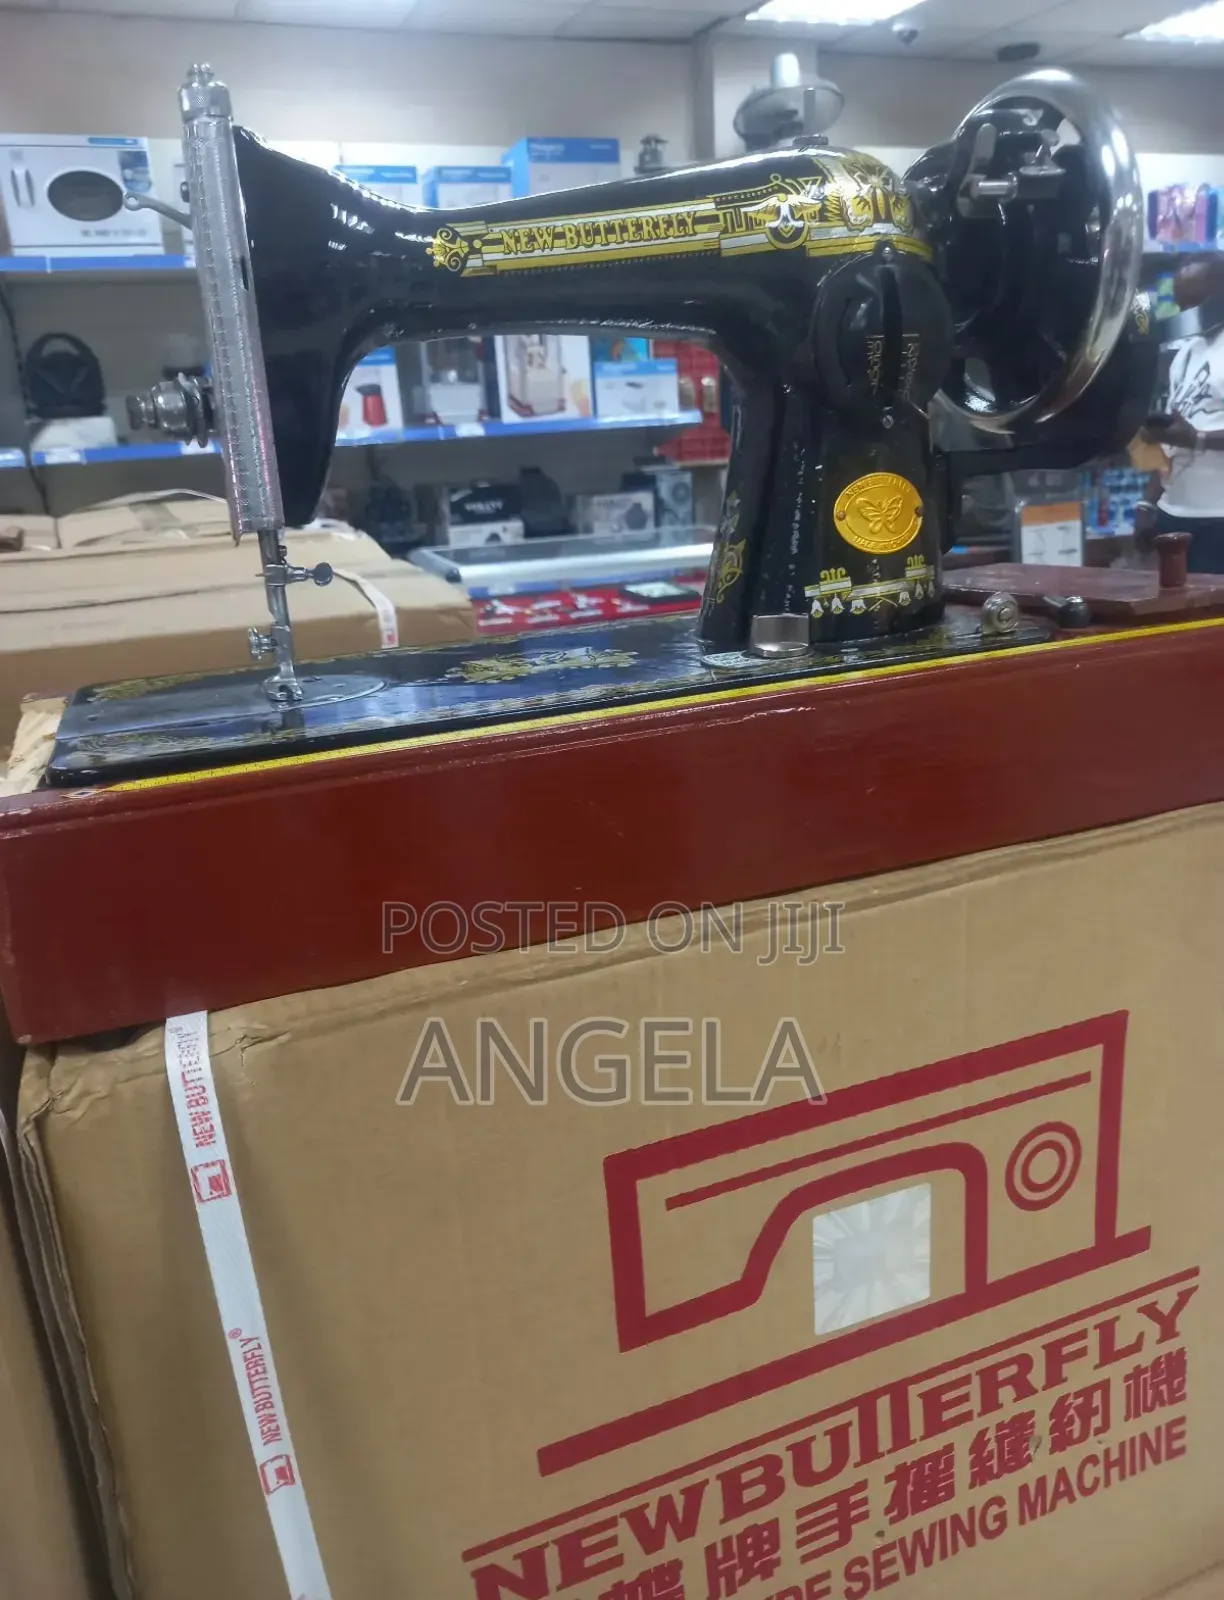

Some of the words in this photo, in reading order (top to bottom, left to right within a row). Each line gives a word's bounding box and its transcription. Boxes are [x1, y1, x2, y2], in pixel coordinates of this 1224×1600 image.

[500, 225, 554, 255] NEW
[564, 211, 698, 249] BUTTERFLY
[189, 1110, 216, 1149] NEW
[257, 1412, 282, 1447] NEW
[843, 1495, 1008, 1600] SEWING
[1018, 1415, 1187, 1526] MACHINE
